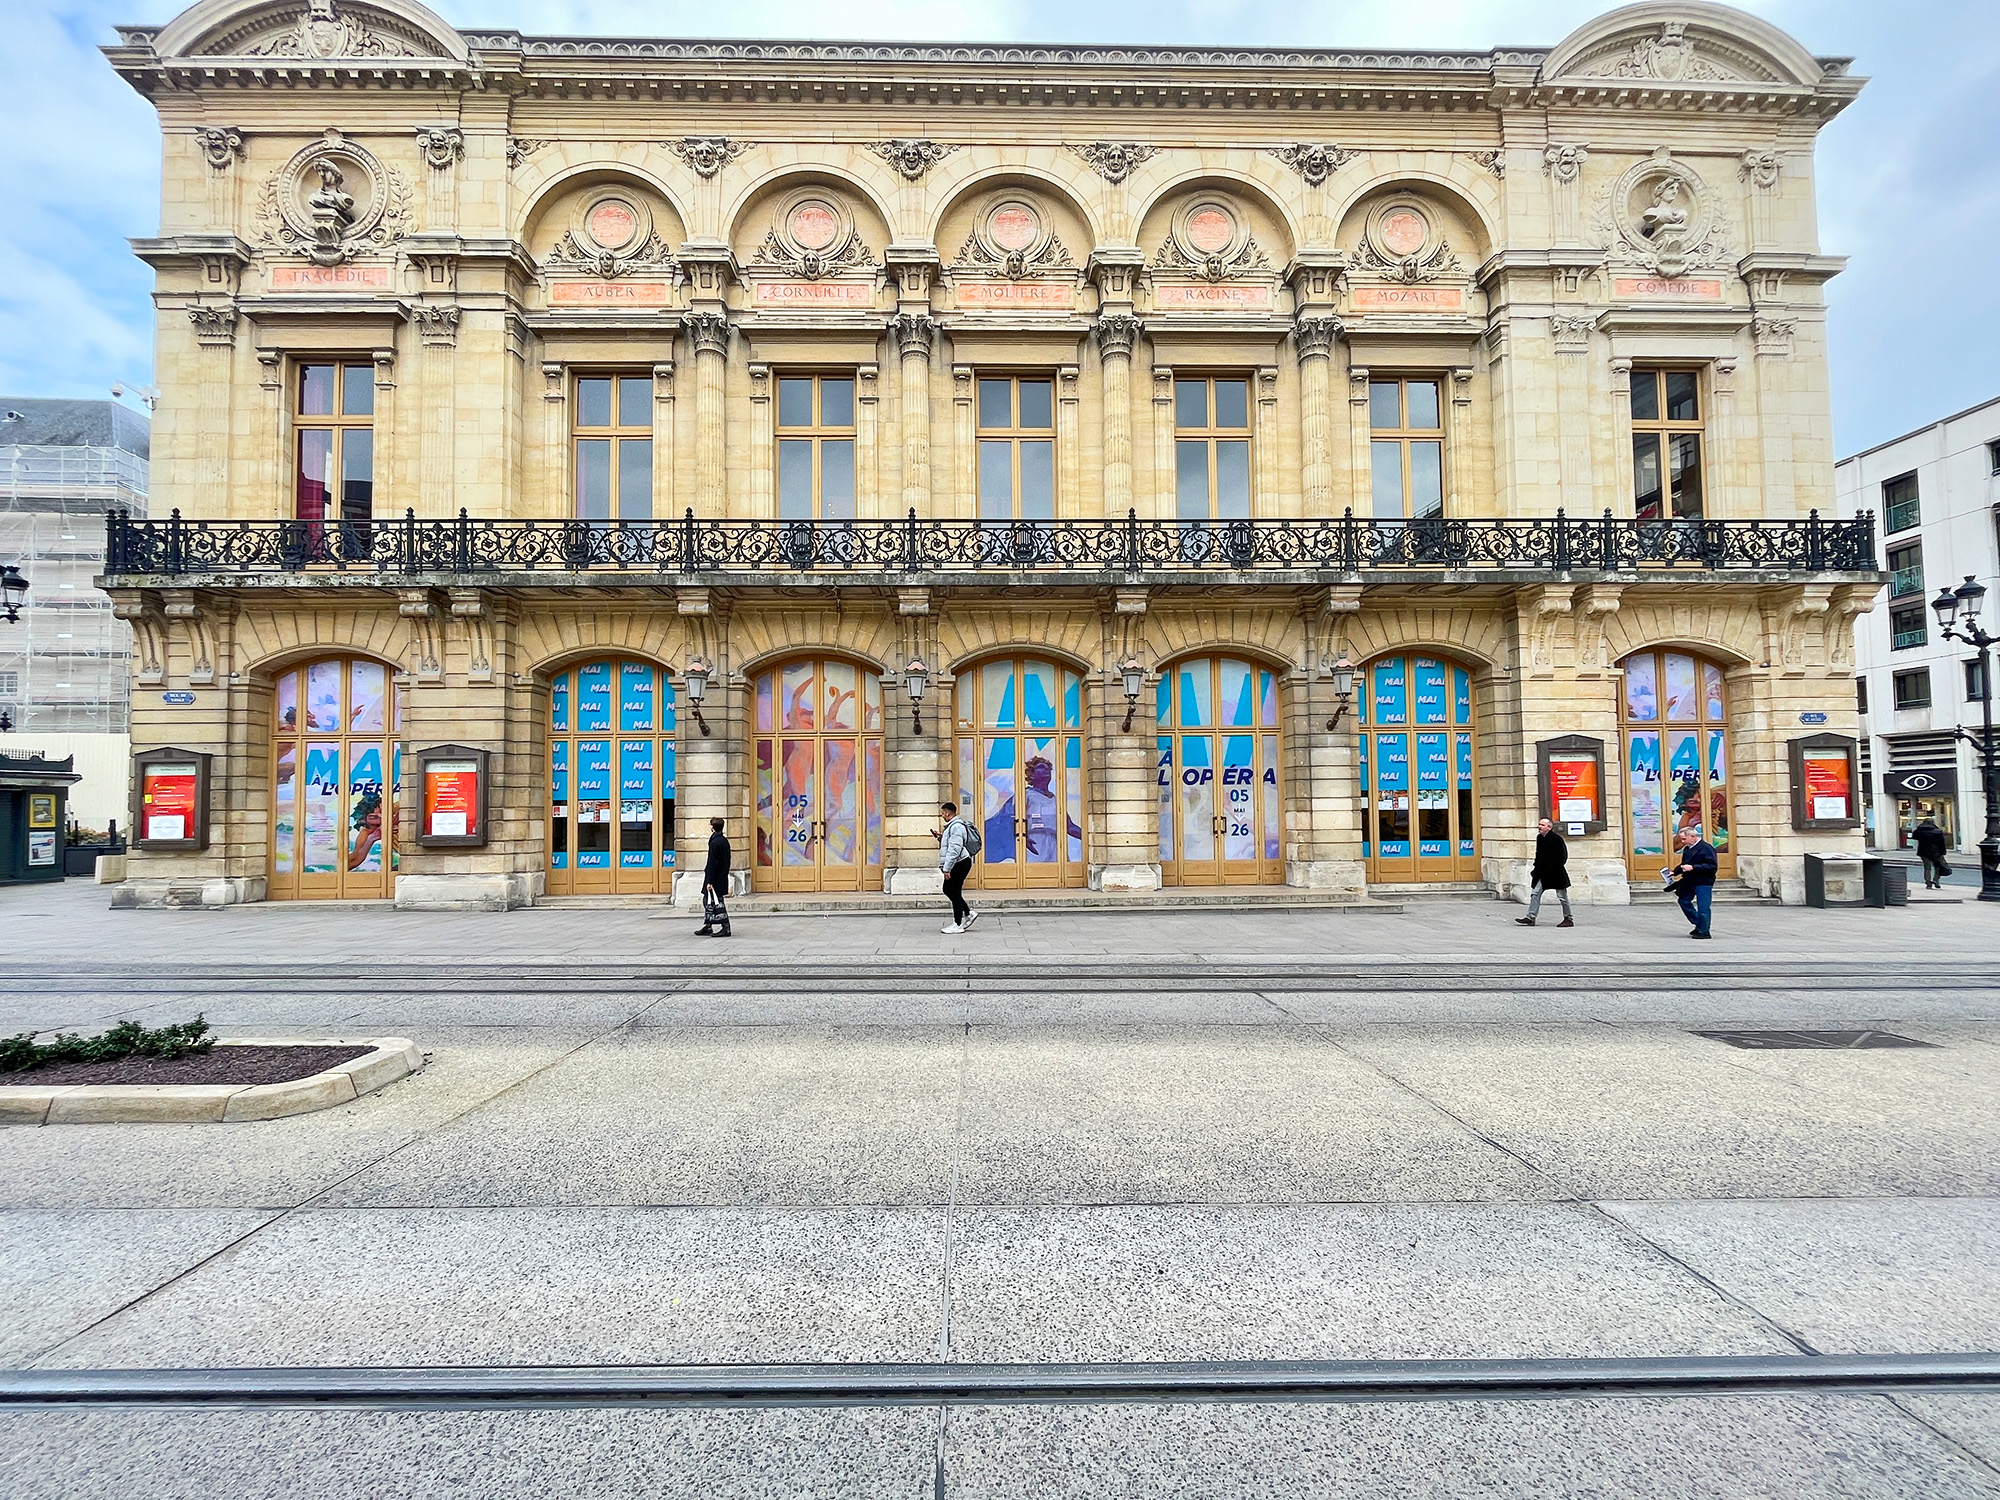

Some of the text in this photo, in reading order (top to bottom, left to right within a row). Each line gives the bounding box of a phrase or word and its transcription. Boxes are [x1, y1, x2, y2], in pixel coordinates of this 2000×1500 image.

[584, 286, 635, 297] AUBER
[772, 287, 855, 298] CORNEILLE
[1185, 289, 1241, 300] RACINE
[1378, 291, 1438, 302] MOZART
[1375, 696, 1396, 704] MAI
[1417, 695, 1437, 704] MAI
[580, 702, 601, 711] MAI
[623, 702, 644, 711] MAI
[1378, 735, 1398, 744] MAI
[1418, 735, 1439, 744] MAI
[580, 743, 601, 752] MAI
[623, 743, 644, 751] MAI
[1630, 736, 1721, 772] MAI
[1635, 762, 1644, 772] À
[1379, 772, 1400, 780] MAI
[1420, 771, 1440, 780] MAI
[312, 775, 321, 786] À
[580, 781, 601, 789] MAI
[623, 780, 644, 789] MAI
[1230, 789, 1249, 802] 05
[788, 794, 808, 808] 05
[1231, 823, 1249, 836] 26
[788, 829, 807, 842] 26
[1381, 844, 1402, 853] MAI
[1420, 844, 1441, 852] MAI
[580, 855, 601, 864] MAI
[623, 855, 644, 863] MAI
